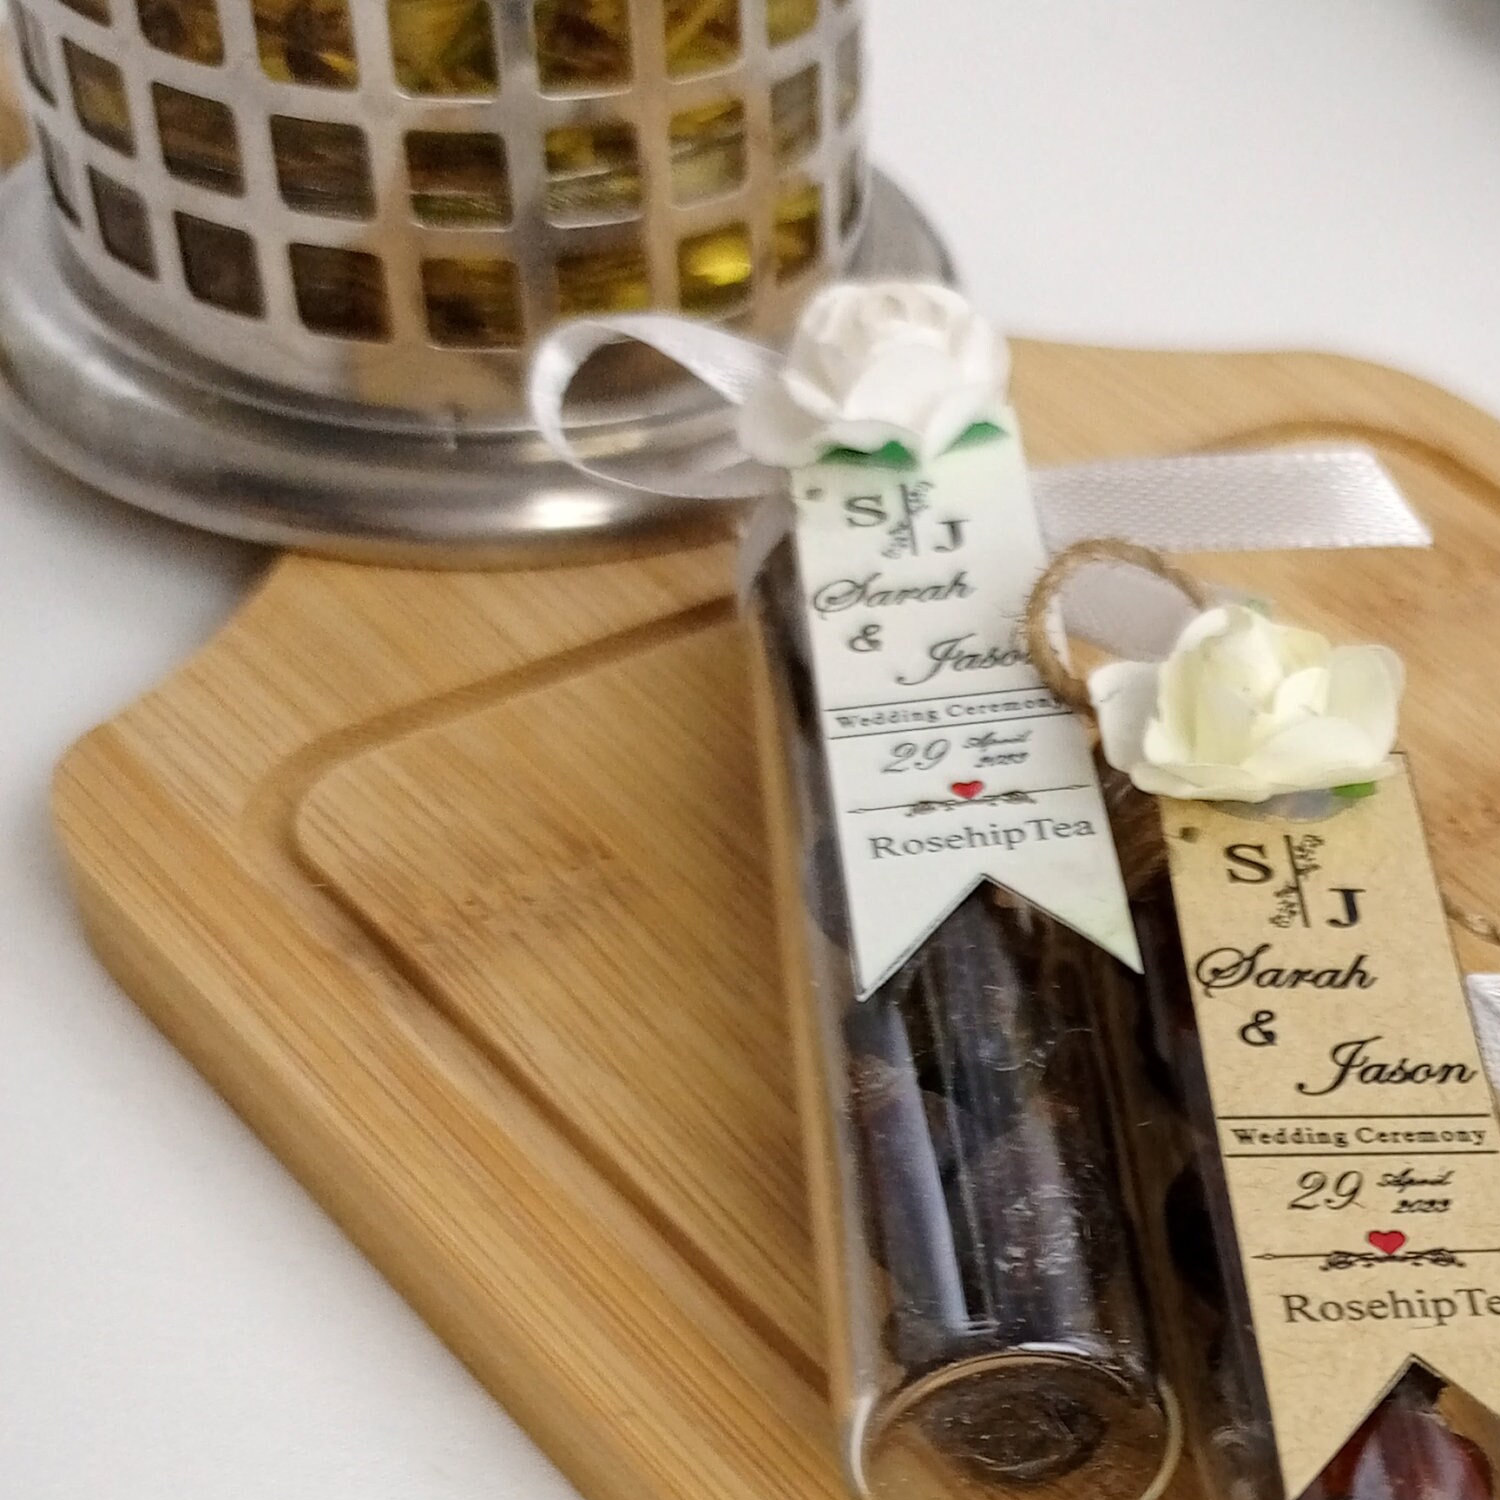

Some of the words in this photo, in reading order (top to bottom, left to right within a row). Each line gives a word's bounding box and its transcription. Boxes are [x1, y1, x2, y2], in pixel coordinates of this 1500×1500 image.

[844, 494, 888, 527] S
[933, 517, 970, 553] J
[813, 571, 978, 620] Sarah
[836, 709, 940, 729] Wedding
[880, 738, 952, 774] 29
[868, 818, 1097, 859] RosehipTea
[1223, 843, 1274, 884] S
[1325, 888, 1367, 928] J
[1195, 943, 1377, 998] Sarah
[1240, 1010, 1277, 1046] &
[1294, 1036, 1478, 1096] Jason
[1230, 1128, 1349, 1148] Wedding
[1354, 1126, 1487, 1145] Ceremony
[1287, 1170, 1365, 1211] 29
